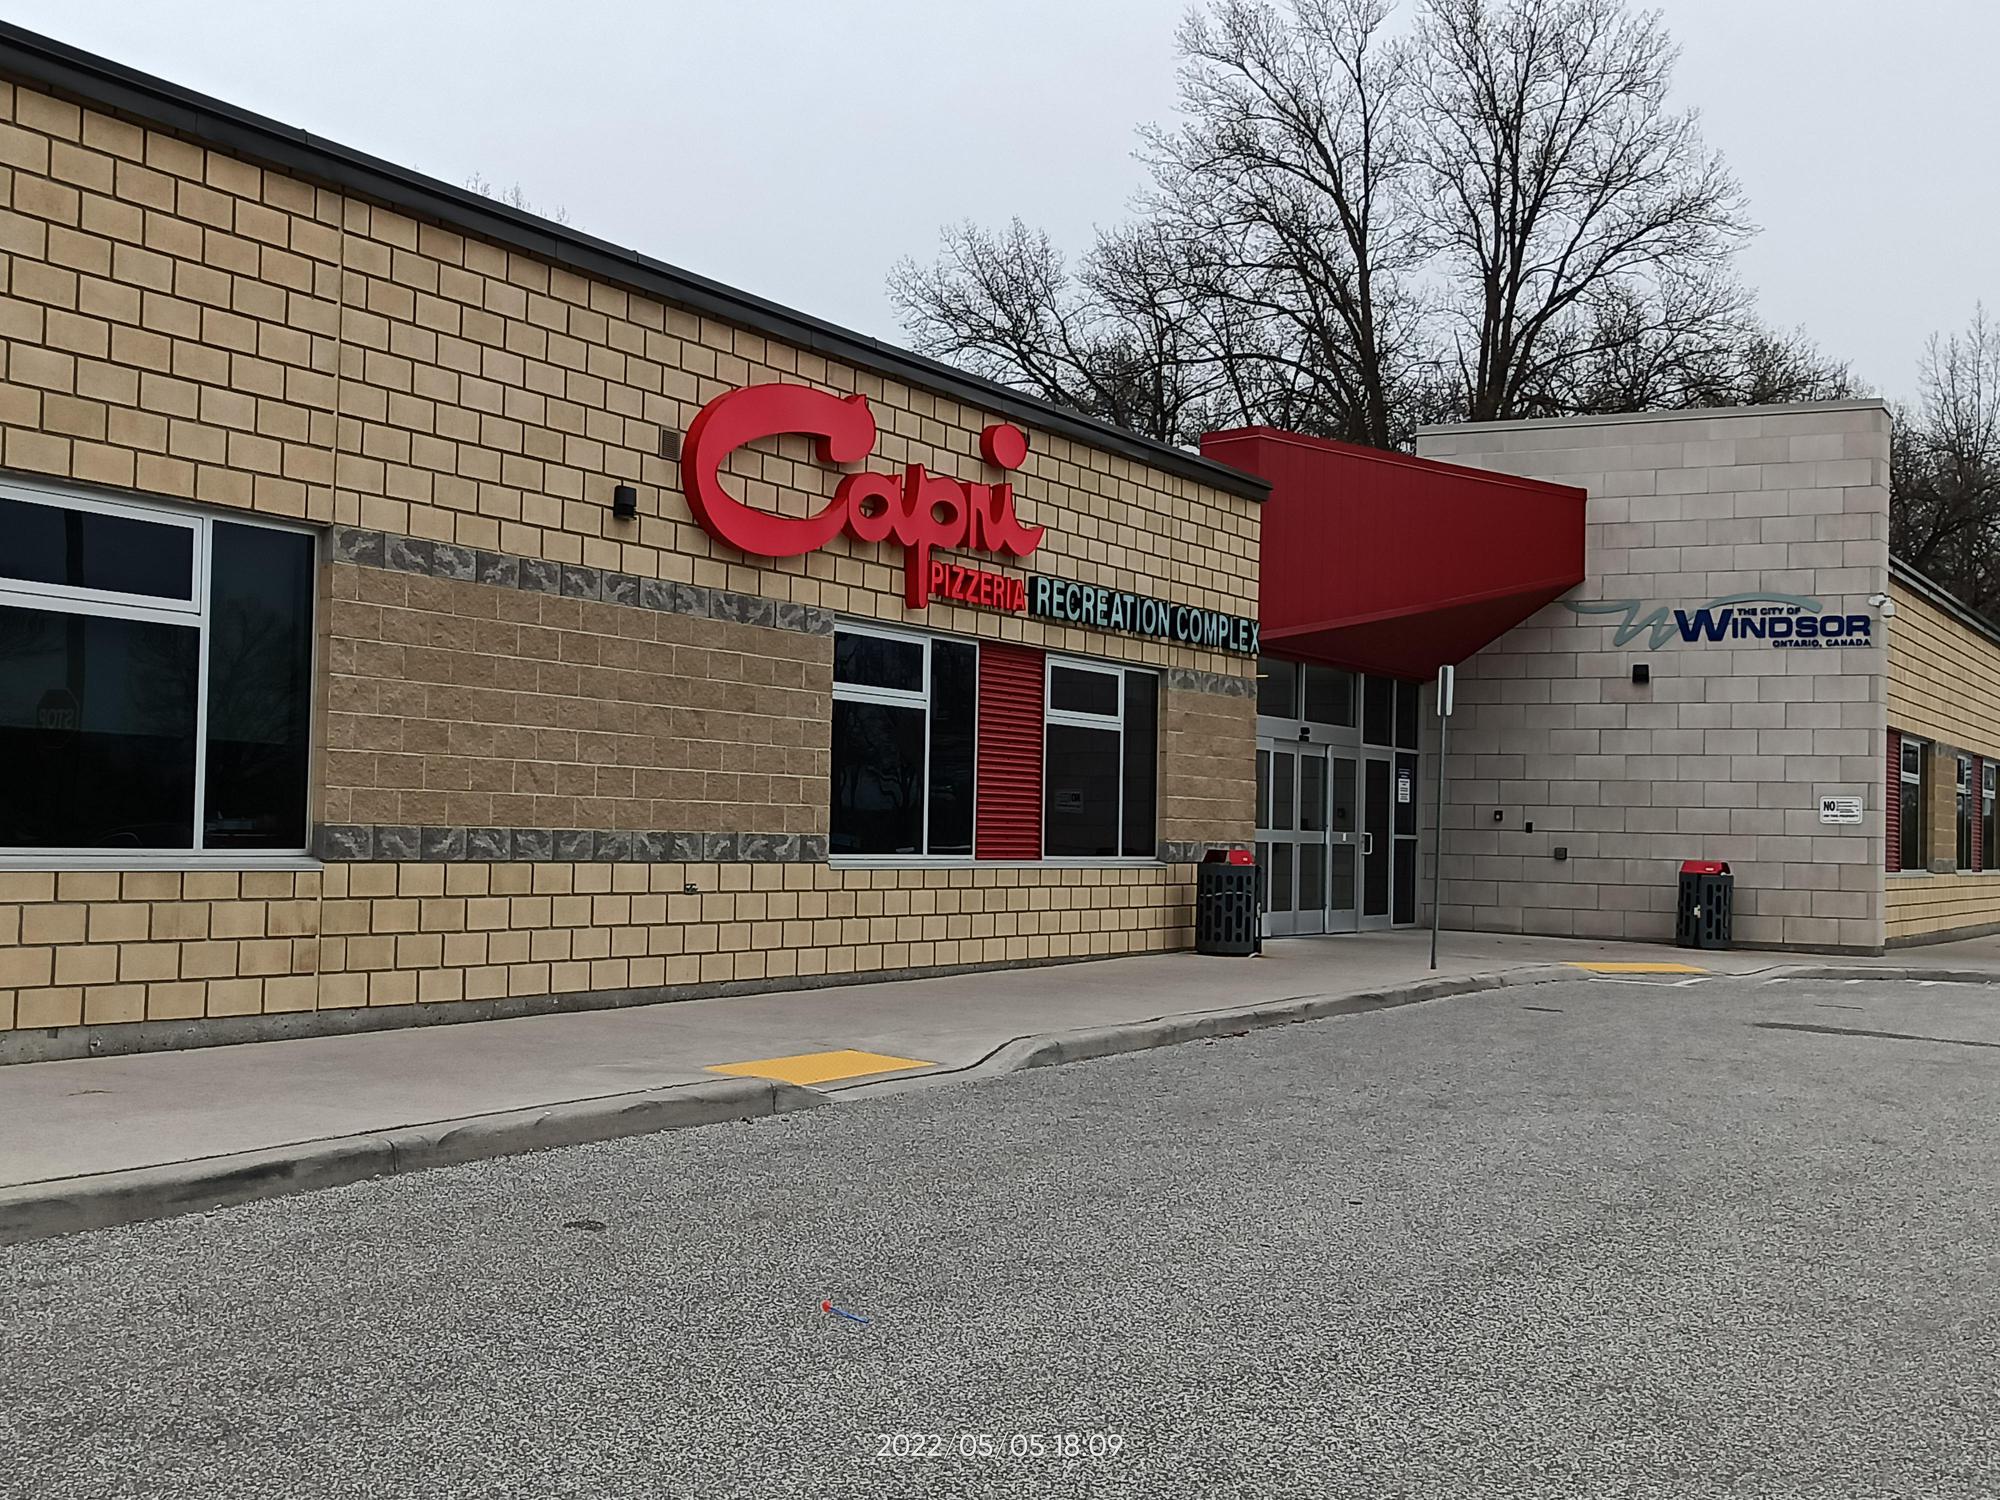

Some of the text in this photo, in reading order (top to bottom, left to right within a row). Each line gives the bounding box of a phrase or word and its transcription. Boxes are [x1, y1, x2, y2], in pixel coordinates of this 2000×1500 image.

[681, 383, 1045, 609] Capri
[930, 559, 1026, 612] PIZZERIA
[1034, 576, 1260, 654] RECREATION COMPLEX
[1673, 609, 1871, 642] WINDSOR
[1737, 606, 1801, 616] THE CITY OF
[1825, 638, 1871, 647] CANADA
[1823, 801, 1836, 811] NO
